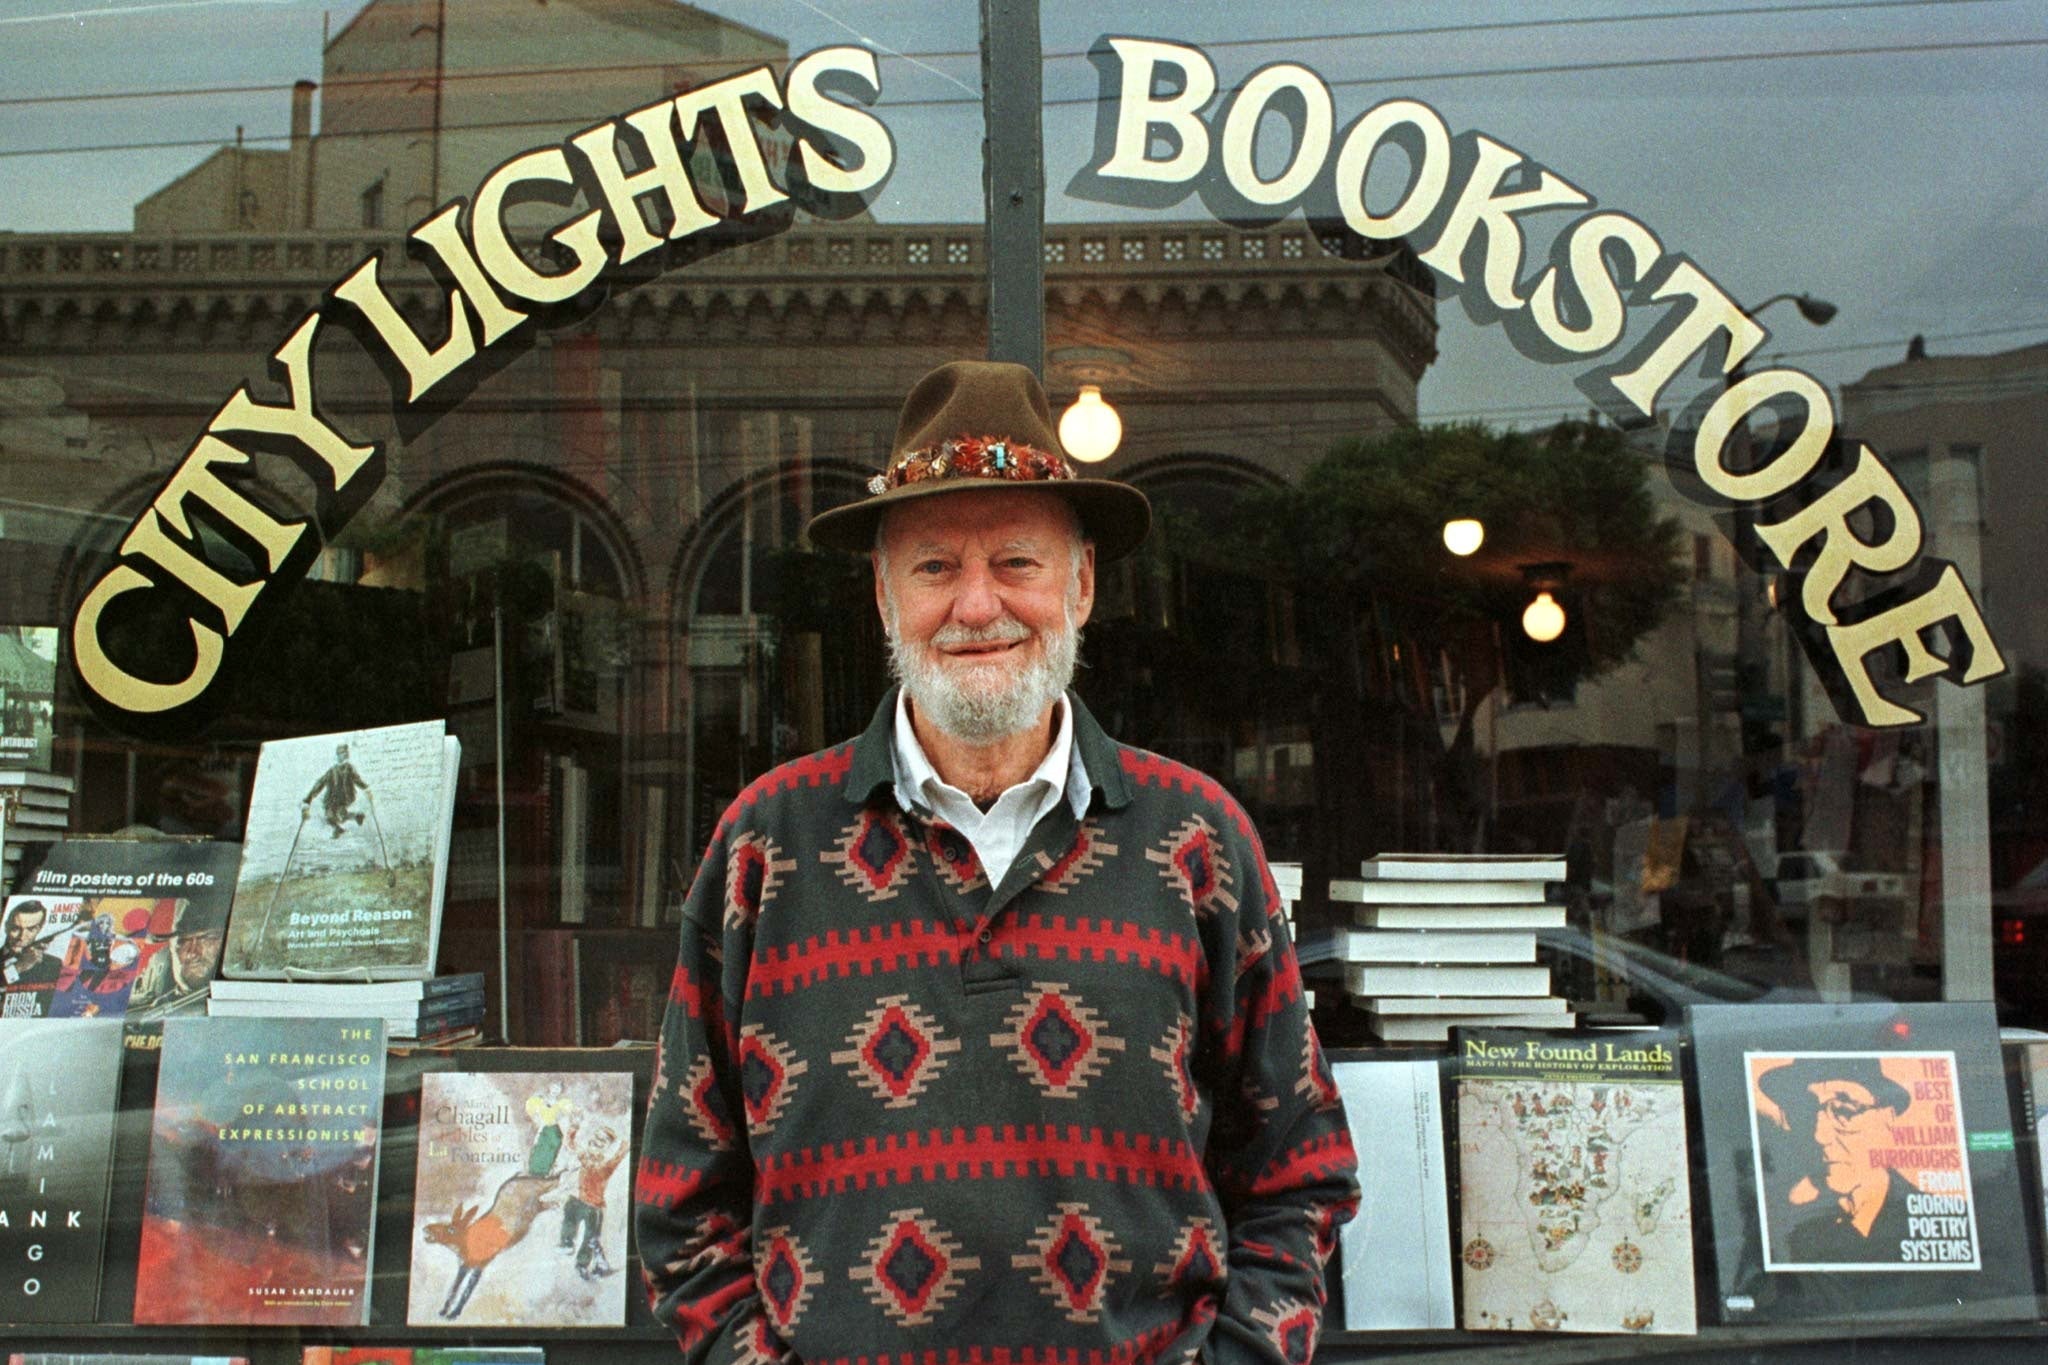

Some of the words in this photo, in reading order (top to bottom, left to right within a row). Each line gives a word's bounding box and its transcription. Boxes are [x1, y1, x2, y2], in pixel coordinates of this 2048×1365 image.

[72, 313, 377, 714] CITY
[334, 46, 894, 404] LIGHTS
[1096, 37, 2007, 728] BOOKSTORE
[36, 870, 67, 884] film
[69, 872, 133, 888] posters
[136, 871, 154, 886] of
[156, 872, 183, 886] the
[185, 872, 214, 886] 60s
[60, 912, 81, 924] BAC
[289, 910, 350, 927] Beyond
[352, 909, 413, 922] Reason
[288, 930, 304, 939] Art
[329, 927, 380, 939] Psychosis
[4, 992, 38, 1006] FROM
[341, 1029, 372, 1040] THE
[225, 1053, 260, 1065] SAN
[270, 1054, 371, 1065] FRANCISCO
[1465, 1040, 1518, 1060] New
[1525, 1041, 1597, 1062] Found
[1605, 1043, 1673, 1063] Lands
[1498, 1060, 1508, 1068] IN
[1534, 1061, 1580, 1070] HISTORY
[1581, 1062, 1595, 1070] OF
[1598, 1063, 1673, 1072] EXPLORATION
[1919, 1059, 1949, 1078] THE
[298, 1079, 369, 1090] SCHOOL
[1914, 1081, 1950, 1101] BEST
[243, 1104, 265, 1115] OF
[275, 1104, 368, 1115] ABSTRACT
[435, 1105, 510, 1130] Chagall
[1934, 1103, 1955, 1123] OF
[218, 1129, 366, 1141] EXPRESSIONISM
[1891, 1125, 1957, 1146] WILLIAM
[427, 1141, 448, 1157] La
[451, 1146, 520, 1163] Fontaine
[1869, 1148, 1961, 1169] BURROUGHS
[1918, 1169, 1962, 1191] FROM
[1906, 1193, 1966, 1215] GIORNO
[1907, 1216, 1968, 1238] POETRY
[1900, 1240, 1972, 1262] SYSTEMS
[292, 1288, 355, 1296] LANDAUER
